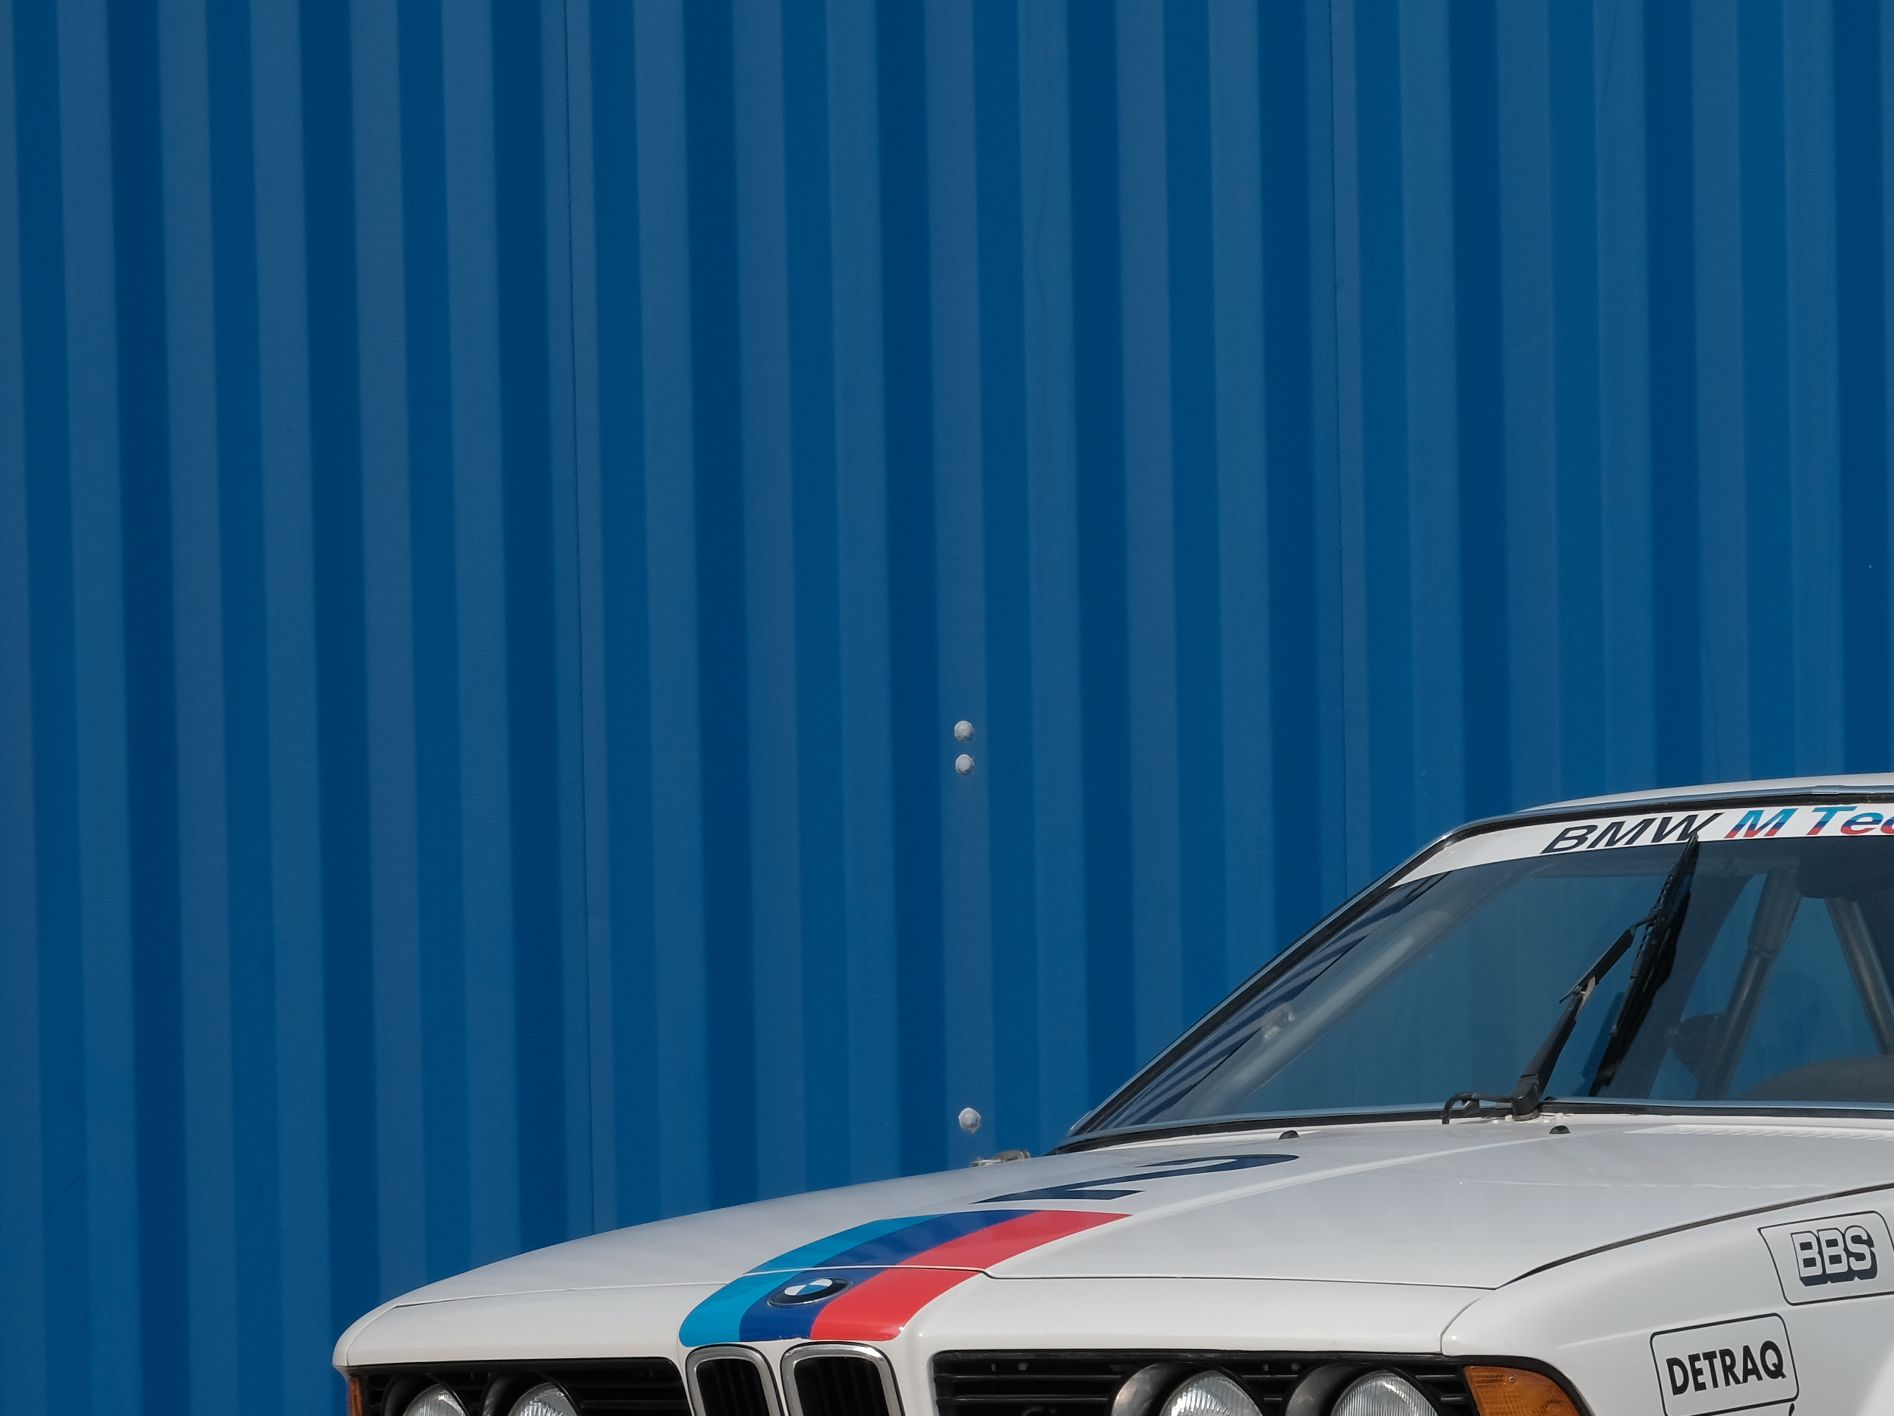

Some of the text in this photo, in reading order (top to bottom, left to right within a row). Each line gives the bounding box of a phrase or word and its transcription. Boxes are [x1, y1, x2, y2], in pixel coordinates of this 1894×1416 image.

[1539, 812, 1724, 855] BMW
[1723, 808, 1800, 839] M
[1790, 1225, 1879, 1287] BBS
[1665, 1340, 1788, 1396] DETRAQ
